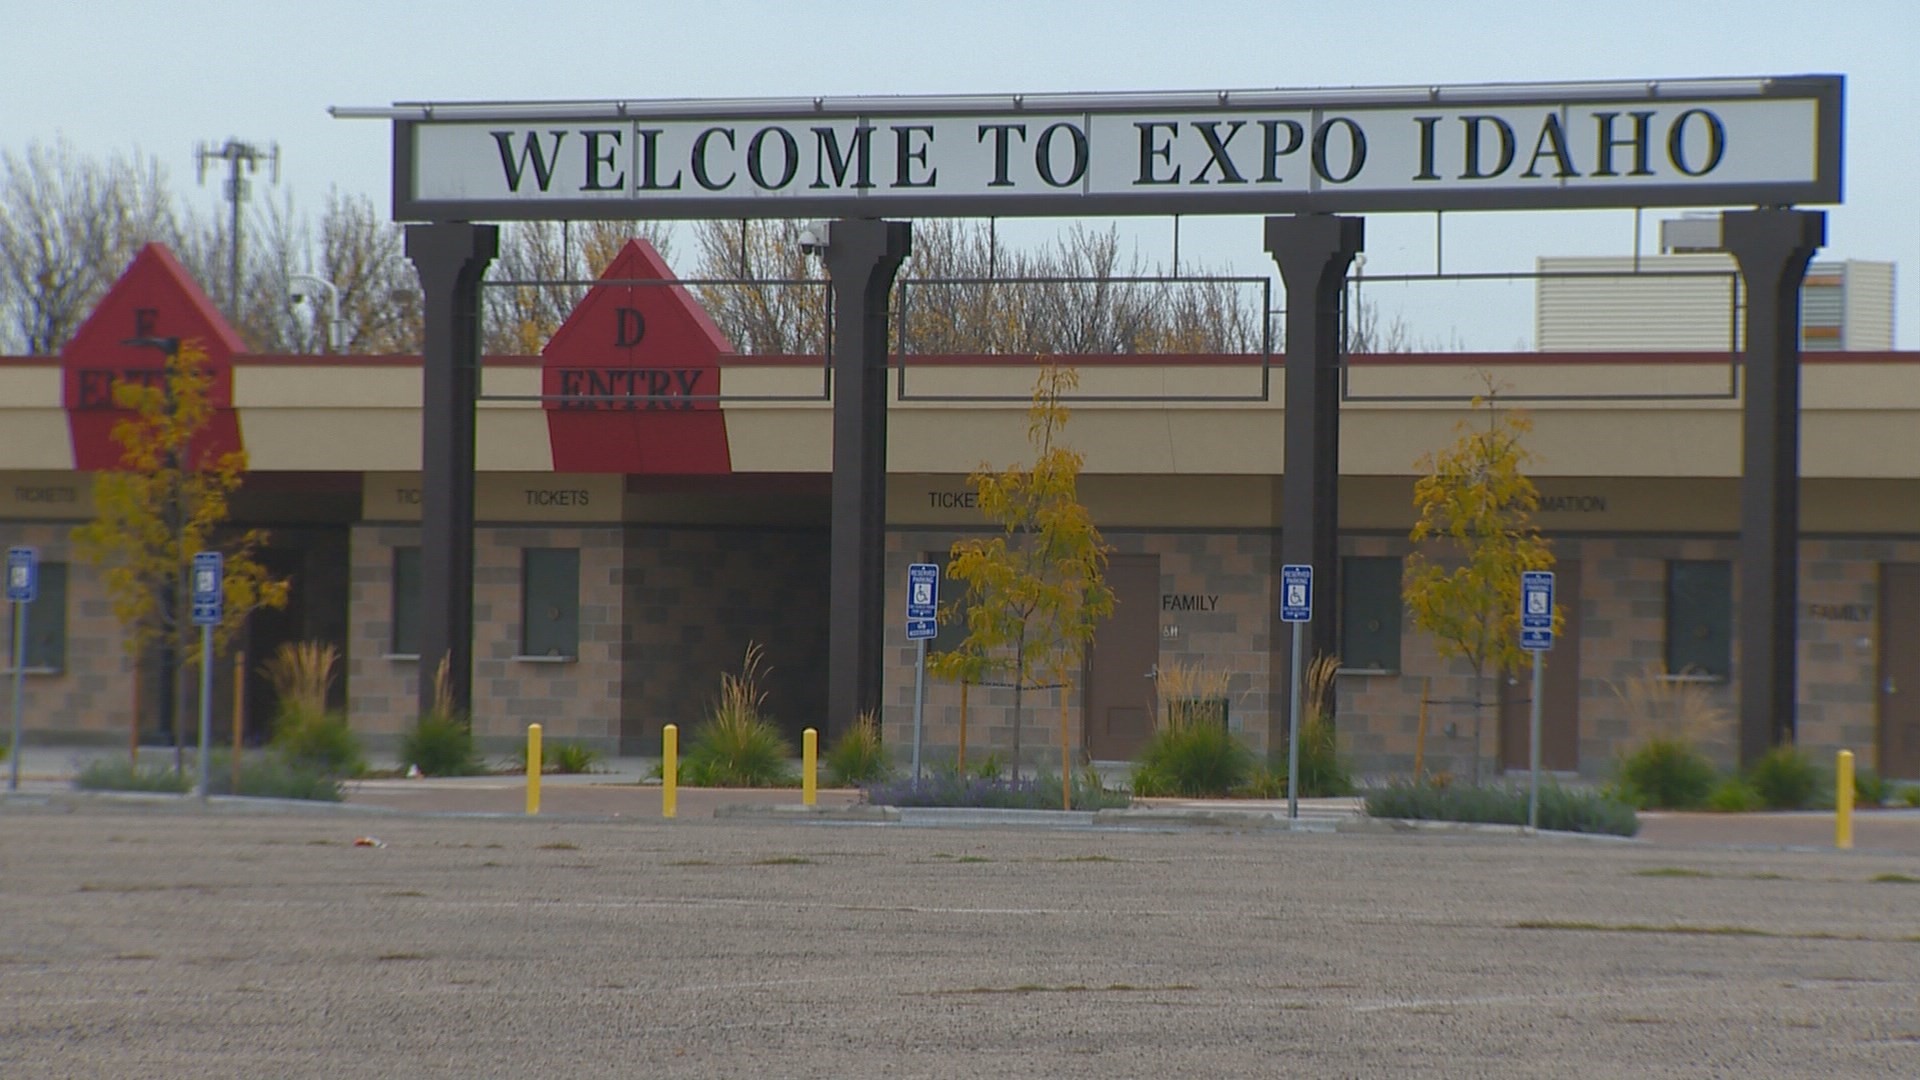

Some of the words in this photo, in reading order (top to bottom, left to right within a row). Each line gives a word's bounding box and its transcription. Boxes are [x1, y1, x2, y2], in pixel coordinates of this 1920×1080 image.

[490, 125, 938, 192] WELCOME
[978, 122, 1089, 188] TO
[1132, 117, 1368, 184] EXPO
[1412, 108, 1727, 181] IDAHO
[614, 307, 646, 348] D
[559, 368, 703, 410] ENTRY
[526, 489, 589, 506] TICKETS
[1162, 594, 1219, 611] FAMILY
